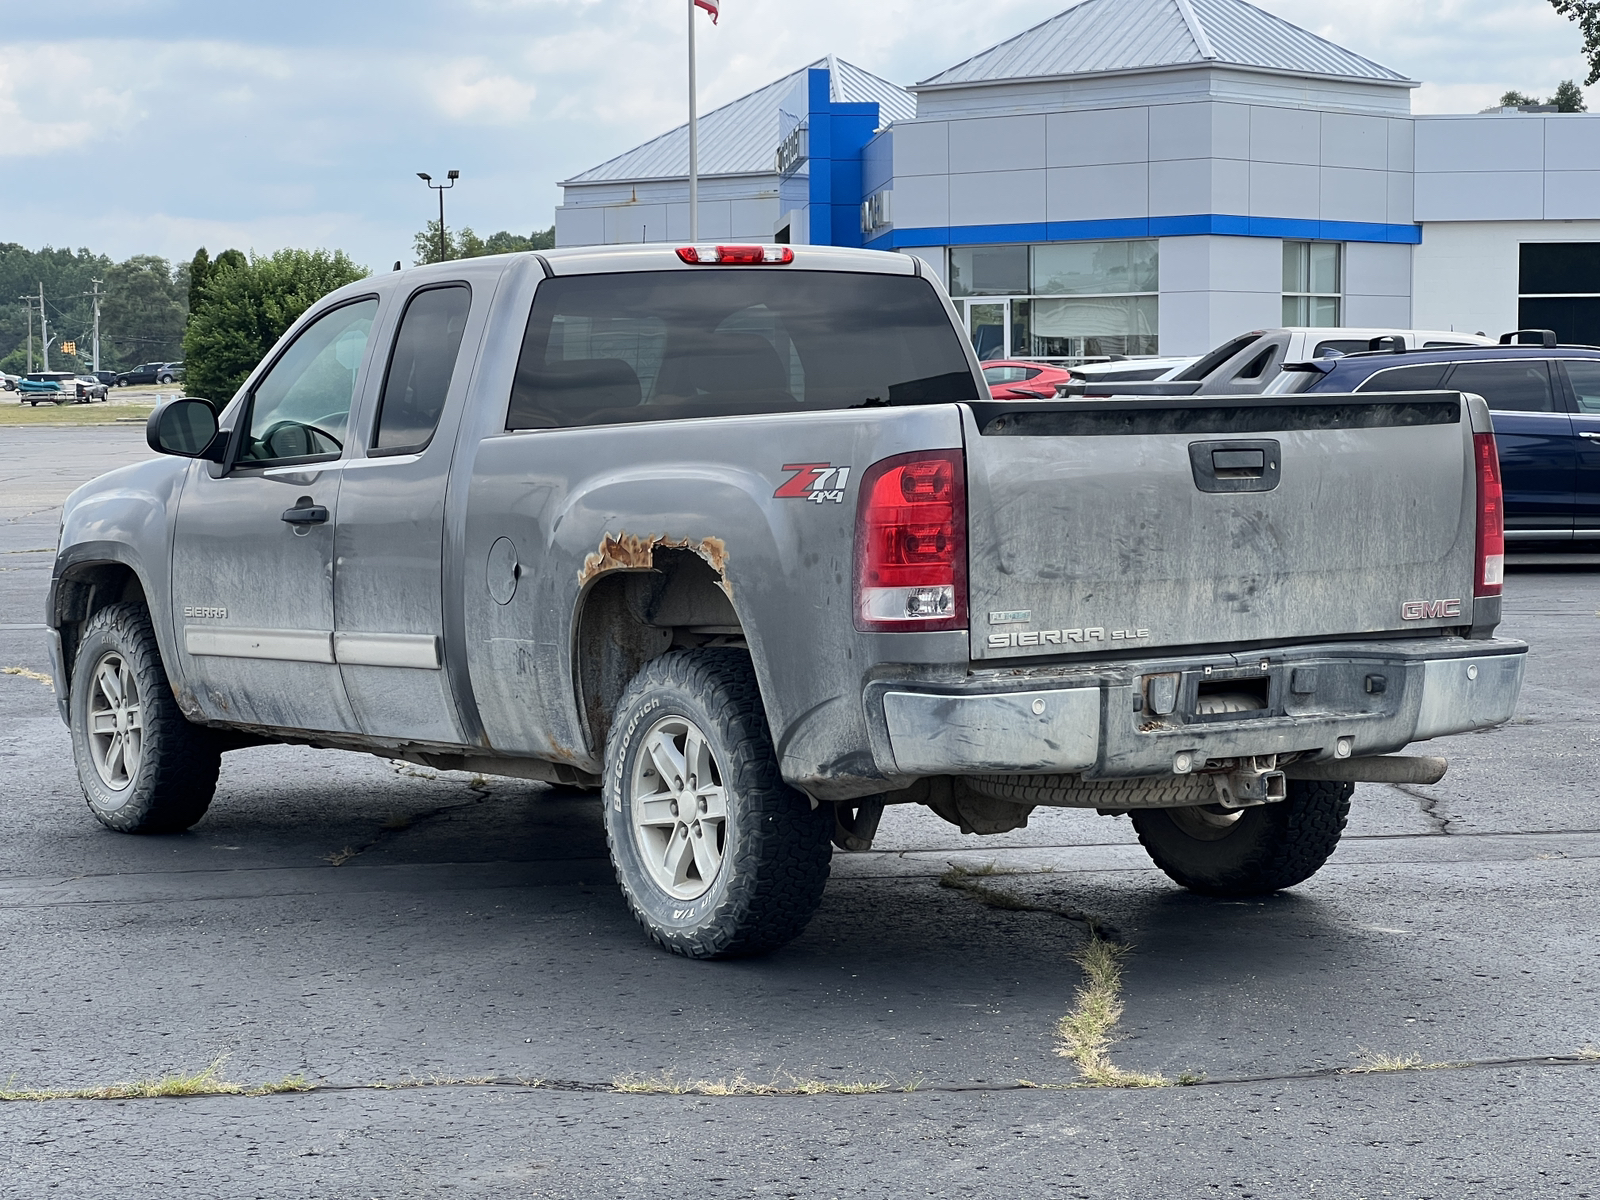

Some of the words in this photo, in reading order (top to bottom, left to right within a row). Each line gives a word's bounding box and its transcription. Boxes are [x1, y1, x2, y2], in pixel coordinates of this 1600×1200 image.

[772, 462, 851, 499] Z71
[184, 606, 228, 619] SIERRA
[1402, 598, 1461, 620] GMC
[988, 627, 1104, 648] SIERRA
[1111, 629, 1149, 640] SLE
[614, 698, 660, 812] BFGoodrich
[673, 907, 696, 919] T/A
